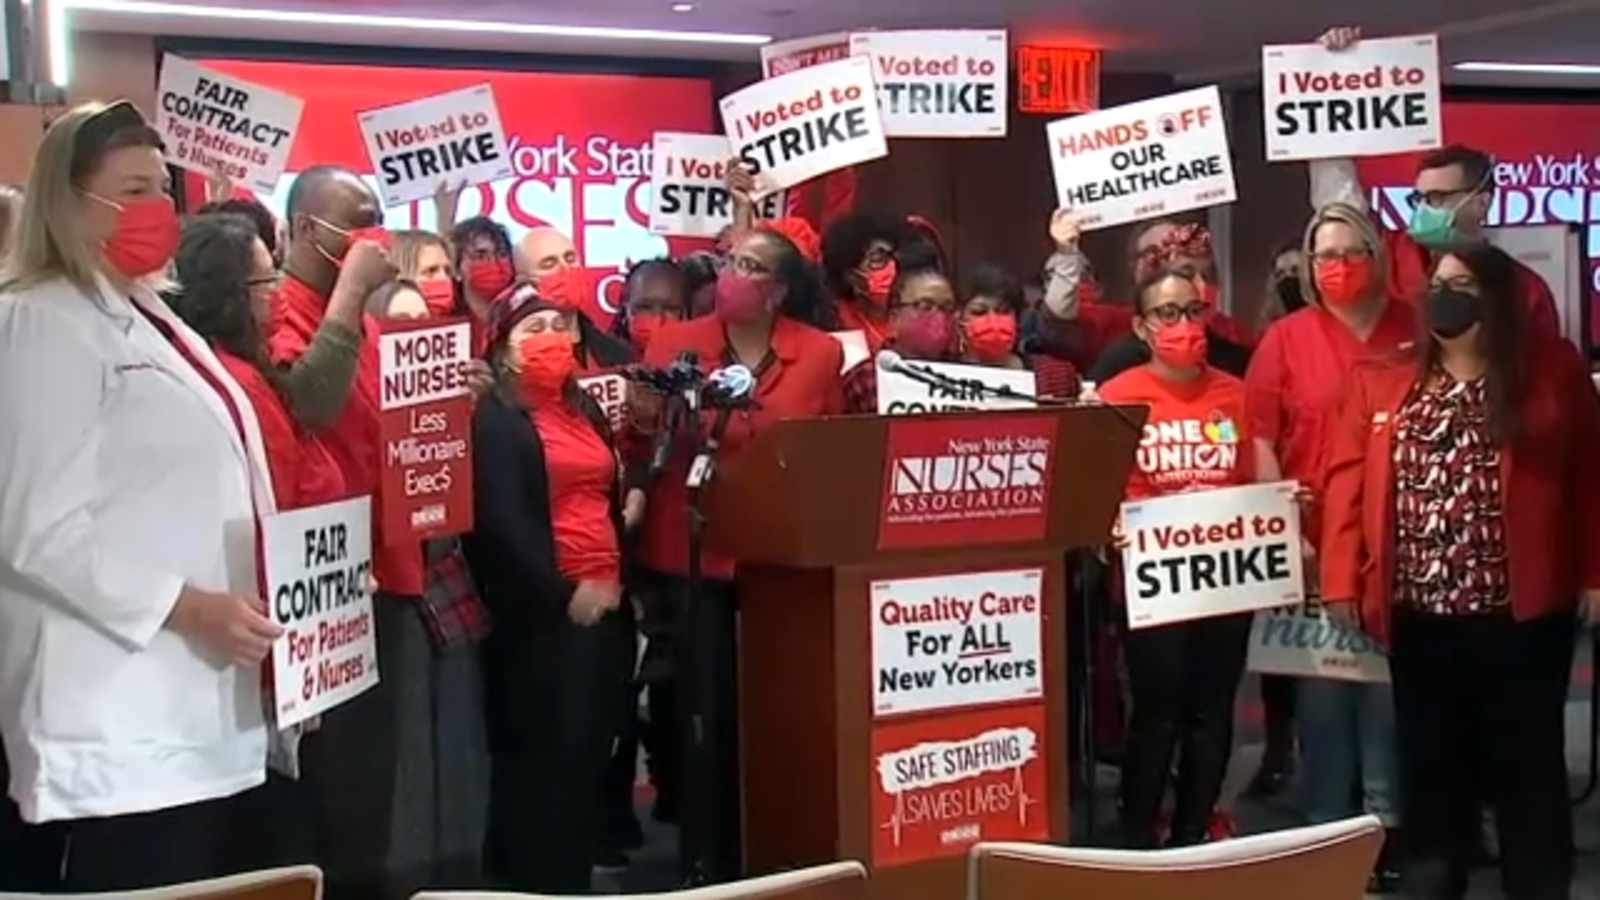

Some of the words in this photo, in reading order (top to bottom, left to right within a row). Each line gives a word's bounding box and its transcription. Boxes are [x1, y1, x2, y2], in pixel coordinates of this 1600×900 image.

[879, 55, 959, 76] Voted
[966, 57, 995, 76] to
[1030, 50, 1092, 106] EXIT
[1278, 72, 1287, 94] I
[1293, 65, 1382, 93] Voted
[1390, 65, 1425, 88] to
[194, 77, 249, 111] FAIR
[736, 119, 744, 140] I
[746, 90, 823, 132] Voted
[829, 84, 862, 104] to
[875, 83, 995, 113] TRIKE
[162, 91, 290, 148] CONTRACT
[374, 132, 385, 151] I
[387, 115, 458, 146] Voted
[461, 110, 488, 129] to
[1276, 92, 1428, 136] STRIKE
[166, 117, 195, 142] For
[194, 124, 269, 166] Patients
[508, 135, 578, 176] ork
[586, 136, 652, 176] Stat
[739, 106, 871, 176] STRIKE
[1057, 119, 1149, 159] HANDS
[1110, 143, 1166, 171] OUR
[177, 142, 189, 160] &
[189, 146, 248, 179] Nurses
[380, 132, 499, 185] STRIKE
[666, 156, 673, 176] I
[680, 159, 730, 179] Vot
[1490, 154, 1533, 187] ew
[1535, 152, 1590, 187] York
[1067, 155, 1223, 206] HEALTHCARE
[394, 331, 457, 368] MORE
[384, 362, 469, 403] NURSES
[410, 409, 447, 434] Less
[1139, 419, 1203, 447] ONE
[387, 435, 466, 468] Millionaire
[949, 439, 982, 455] New
[984, 437, 1014, 453] York
[1016, 435, 1050, 451] State
[1136, 443, 1237, 473] UNION
[404, 464, 452, 496] Exec$
[892, 452, 1049, 495] NURSES
[887, 489, 1044, 513] ASSOCIATION
[304, 522, 348, 568] FAIR
[1137, 529, 1146, 552] I
[1154, 515, 1245, 550] Voted
[1252, 515, 1286, 537] to
[1136, 543, 1291, 599] STRIKE
[879, 595, 974, 627] Quality
[979, 591, 1036, 617] Care
[287, 627, 316, 666] For
[319, 610, 370, 655] Patients
[905, 630, 953, 657] For
[959, 622, 1010, 652] ALL
[302, 664, 314, 701] &
[316, 653, 364, 696] Nurses
[879, 667, 936, 693] New
[941, 657, 1036, 687] Yorkers
[895, 751, 938, 784] SAFE
[943, 735, 1021, 776] STAFFING
[904, 788, 963, 823] SAVES
[967, 783, 1011, 816] LIVES
